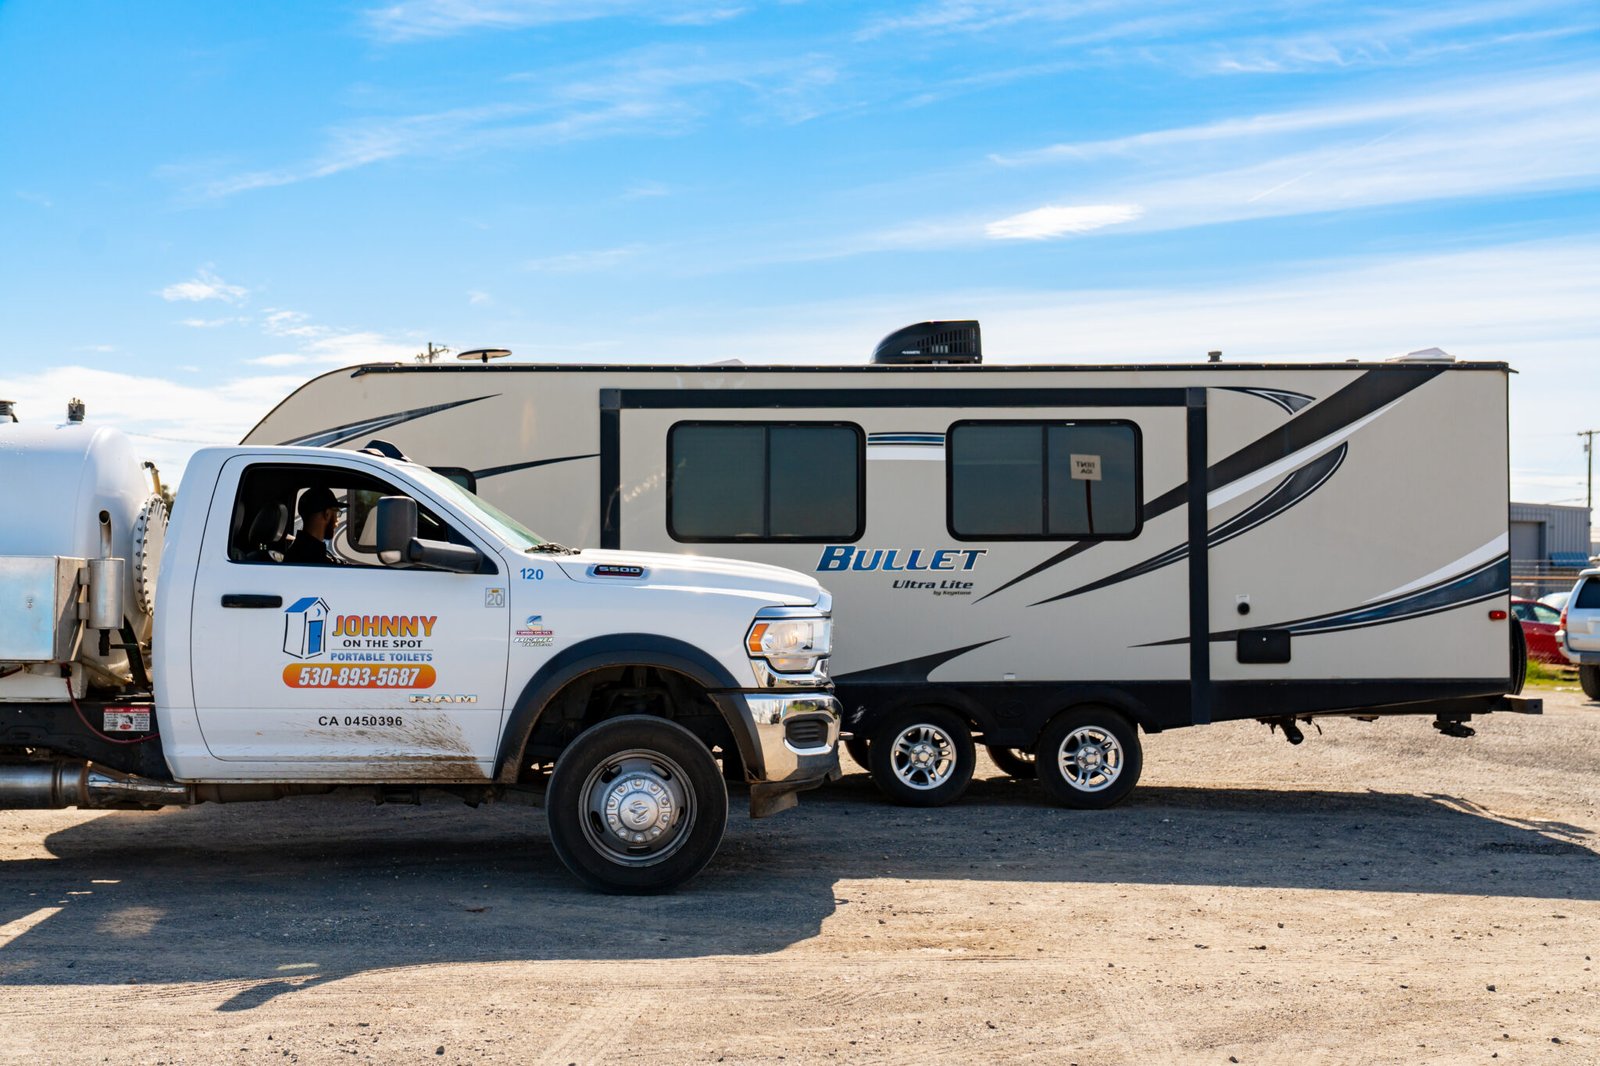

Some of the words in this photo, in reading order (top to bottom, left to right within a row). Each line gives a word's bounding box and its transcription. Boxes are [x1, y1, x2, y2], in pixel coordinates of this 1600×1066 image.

[815, 544, 988, 572] BULLET
[520, 567, 544, 580] 120
[892, 580, 936, 589] Ultra
[940, 580, 974, 589] Lite
[487, 593, 503, 606] 20
[332, 614, 438, 637] JOHNNY
[342, 639, 361, 648] ON
[365, 639, 388, 648] THE
[392, 639, 423, 648] SPOT
[330, 652, 385, 662] PORTABLE
[389, 652, 433, 662] TOILETS
[298, 667, 421, 687] 530-893-5687
[409, 694, 477, 703] RAM
[318, 716, 339, 726] CA
[344, 716, 403, 726] 0450396
